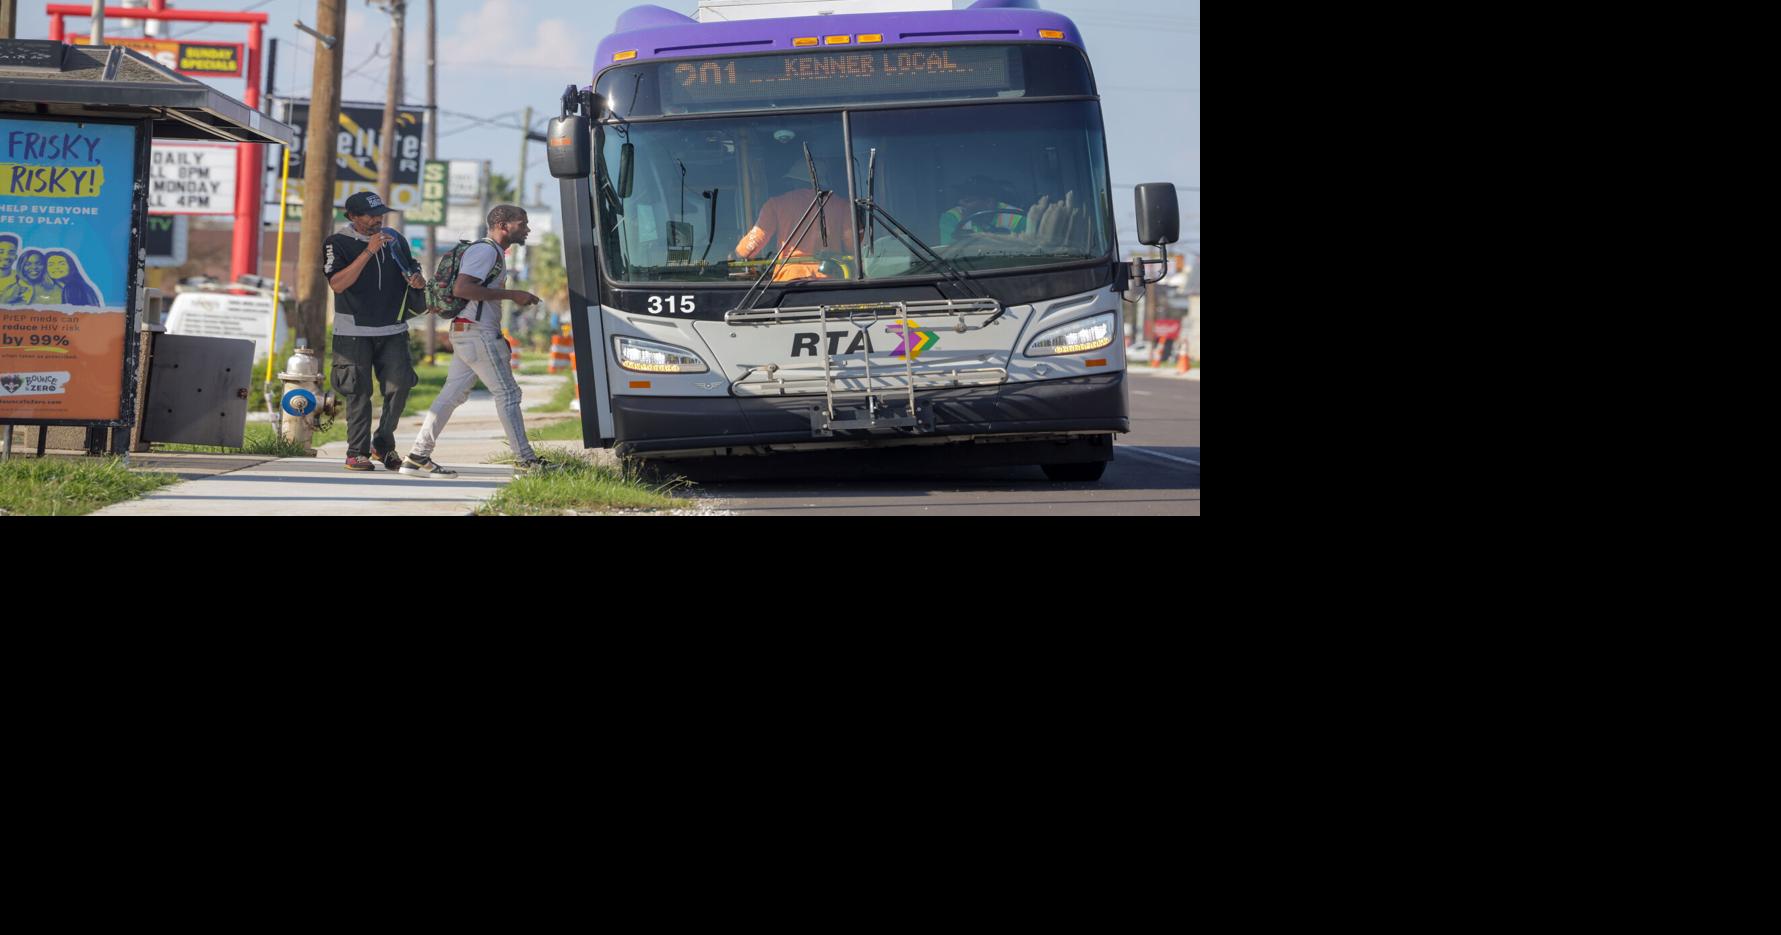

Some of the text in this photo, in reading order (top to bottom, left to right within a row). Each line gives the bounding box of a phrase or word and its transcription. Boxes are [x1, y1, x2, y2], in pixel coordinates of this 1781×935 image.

[185, 47, 233, 60] SUNDAY
[784, 55, 874, 80] KENNER
[883, 50, 958, 75] LOCAL
[8, 130, 101, 166] FRISKY,
[153, 151, 205, 166] DAILY
[10, 164, 96, 196] RISKY!
[154, 180, 221, 195] MONDAY
[176, 195, 210, 208] 4PM
[0, 204, 98, 216] HELP EVERYONE
[0, 215, 75, 226] FE TO PLAY.
[647, 295, 696, 315] 315
[30, 315, 58, 323] meds
[2, 333, 70, 346] by 99%
[790, 330, 875, 358] RTA
